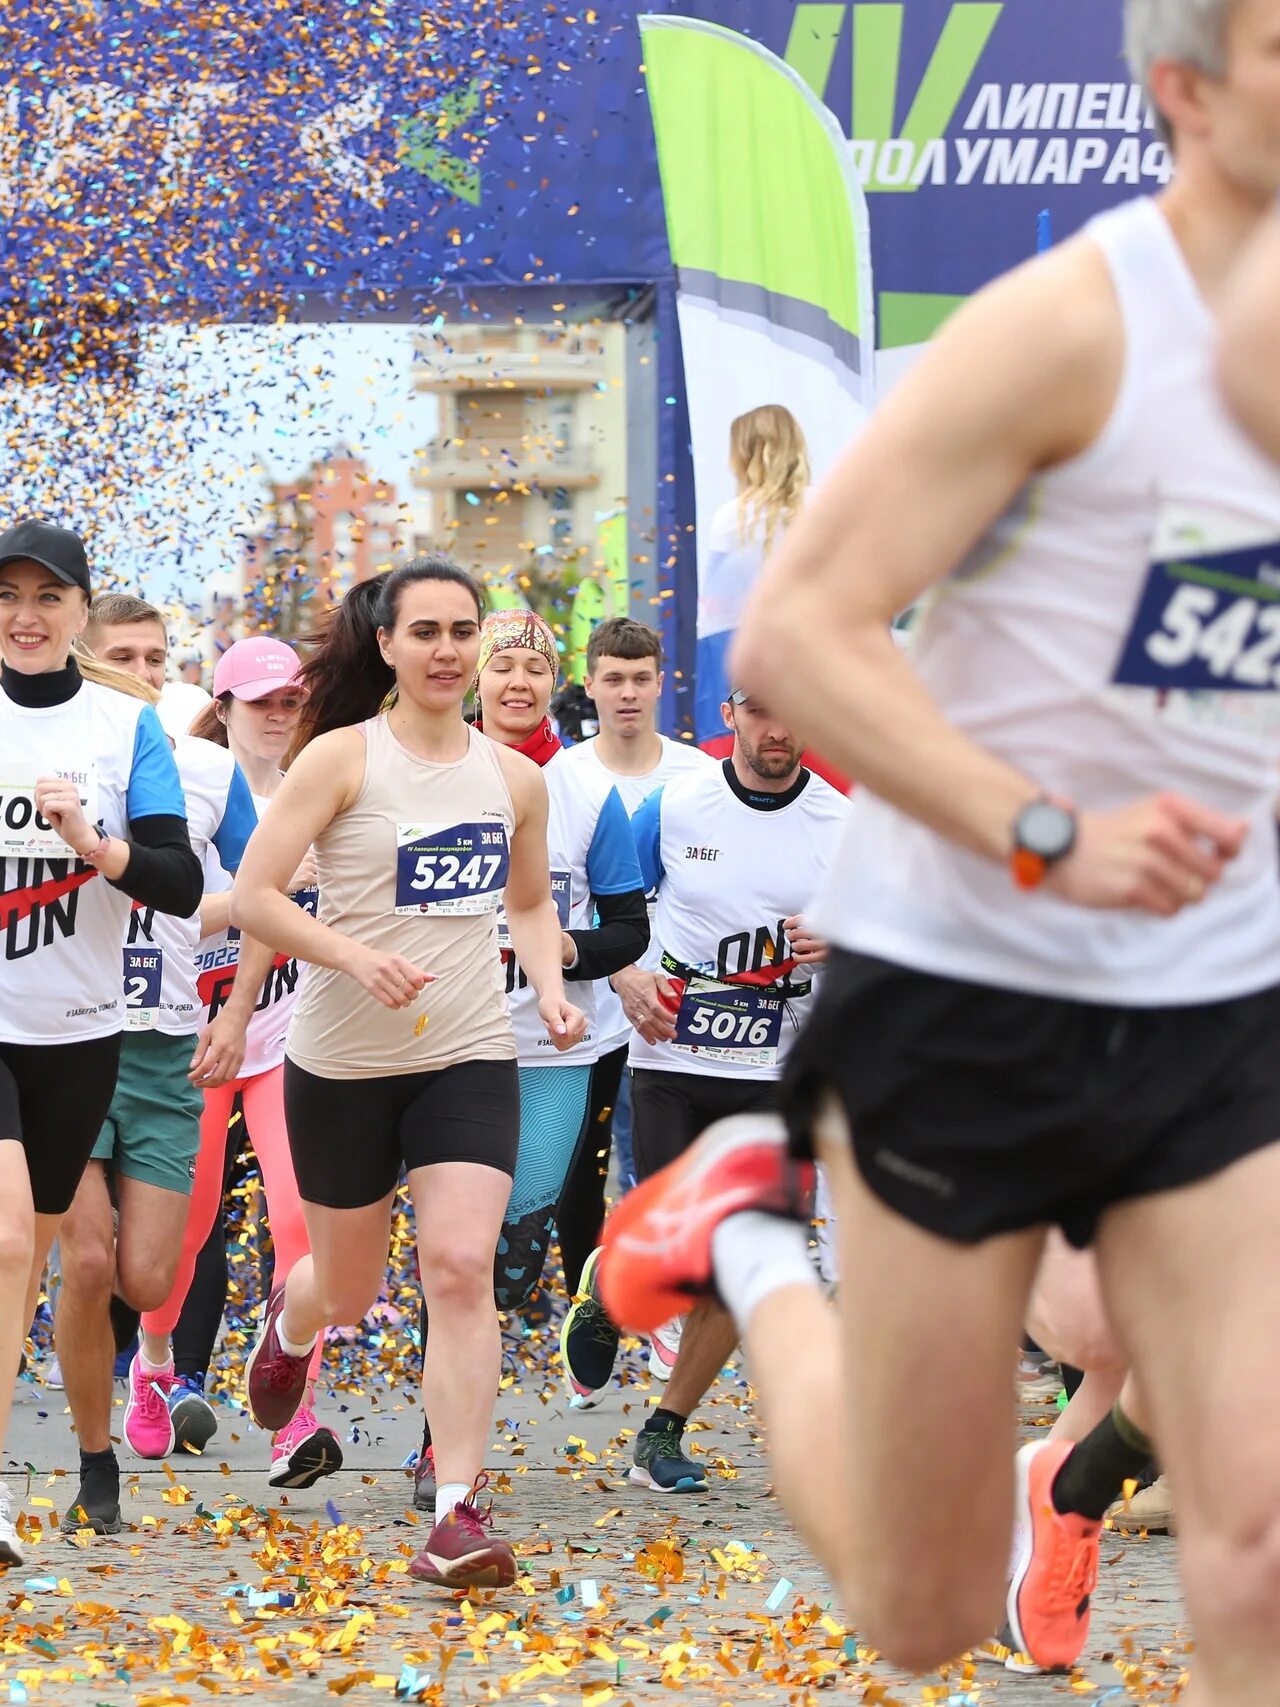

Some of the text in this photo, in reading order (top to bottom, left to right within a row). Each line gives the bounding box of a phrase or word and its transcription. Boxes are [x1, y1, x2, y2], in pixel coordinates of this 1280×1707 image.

[1144, 582, 1280, 686] 542
[410, 855, 501, 890] 5247
[717, 919, 793, 978] ON
[123, 976, 148, 1006] 2
[687, 1007, 772, 1045] 5016
